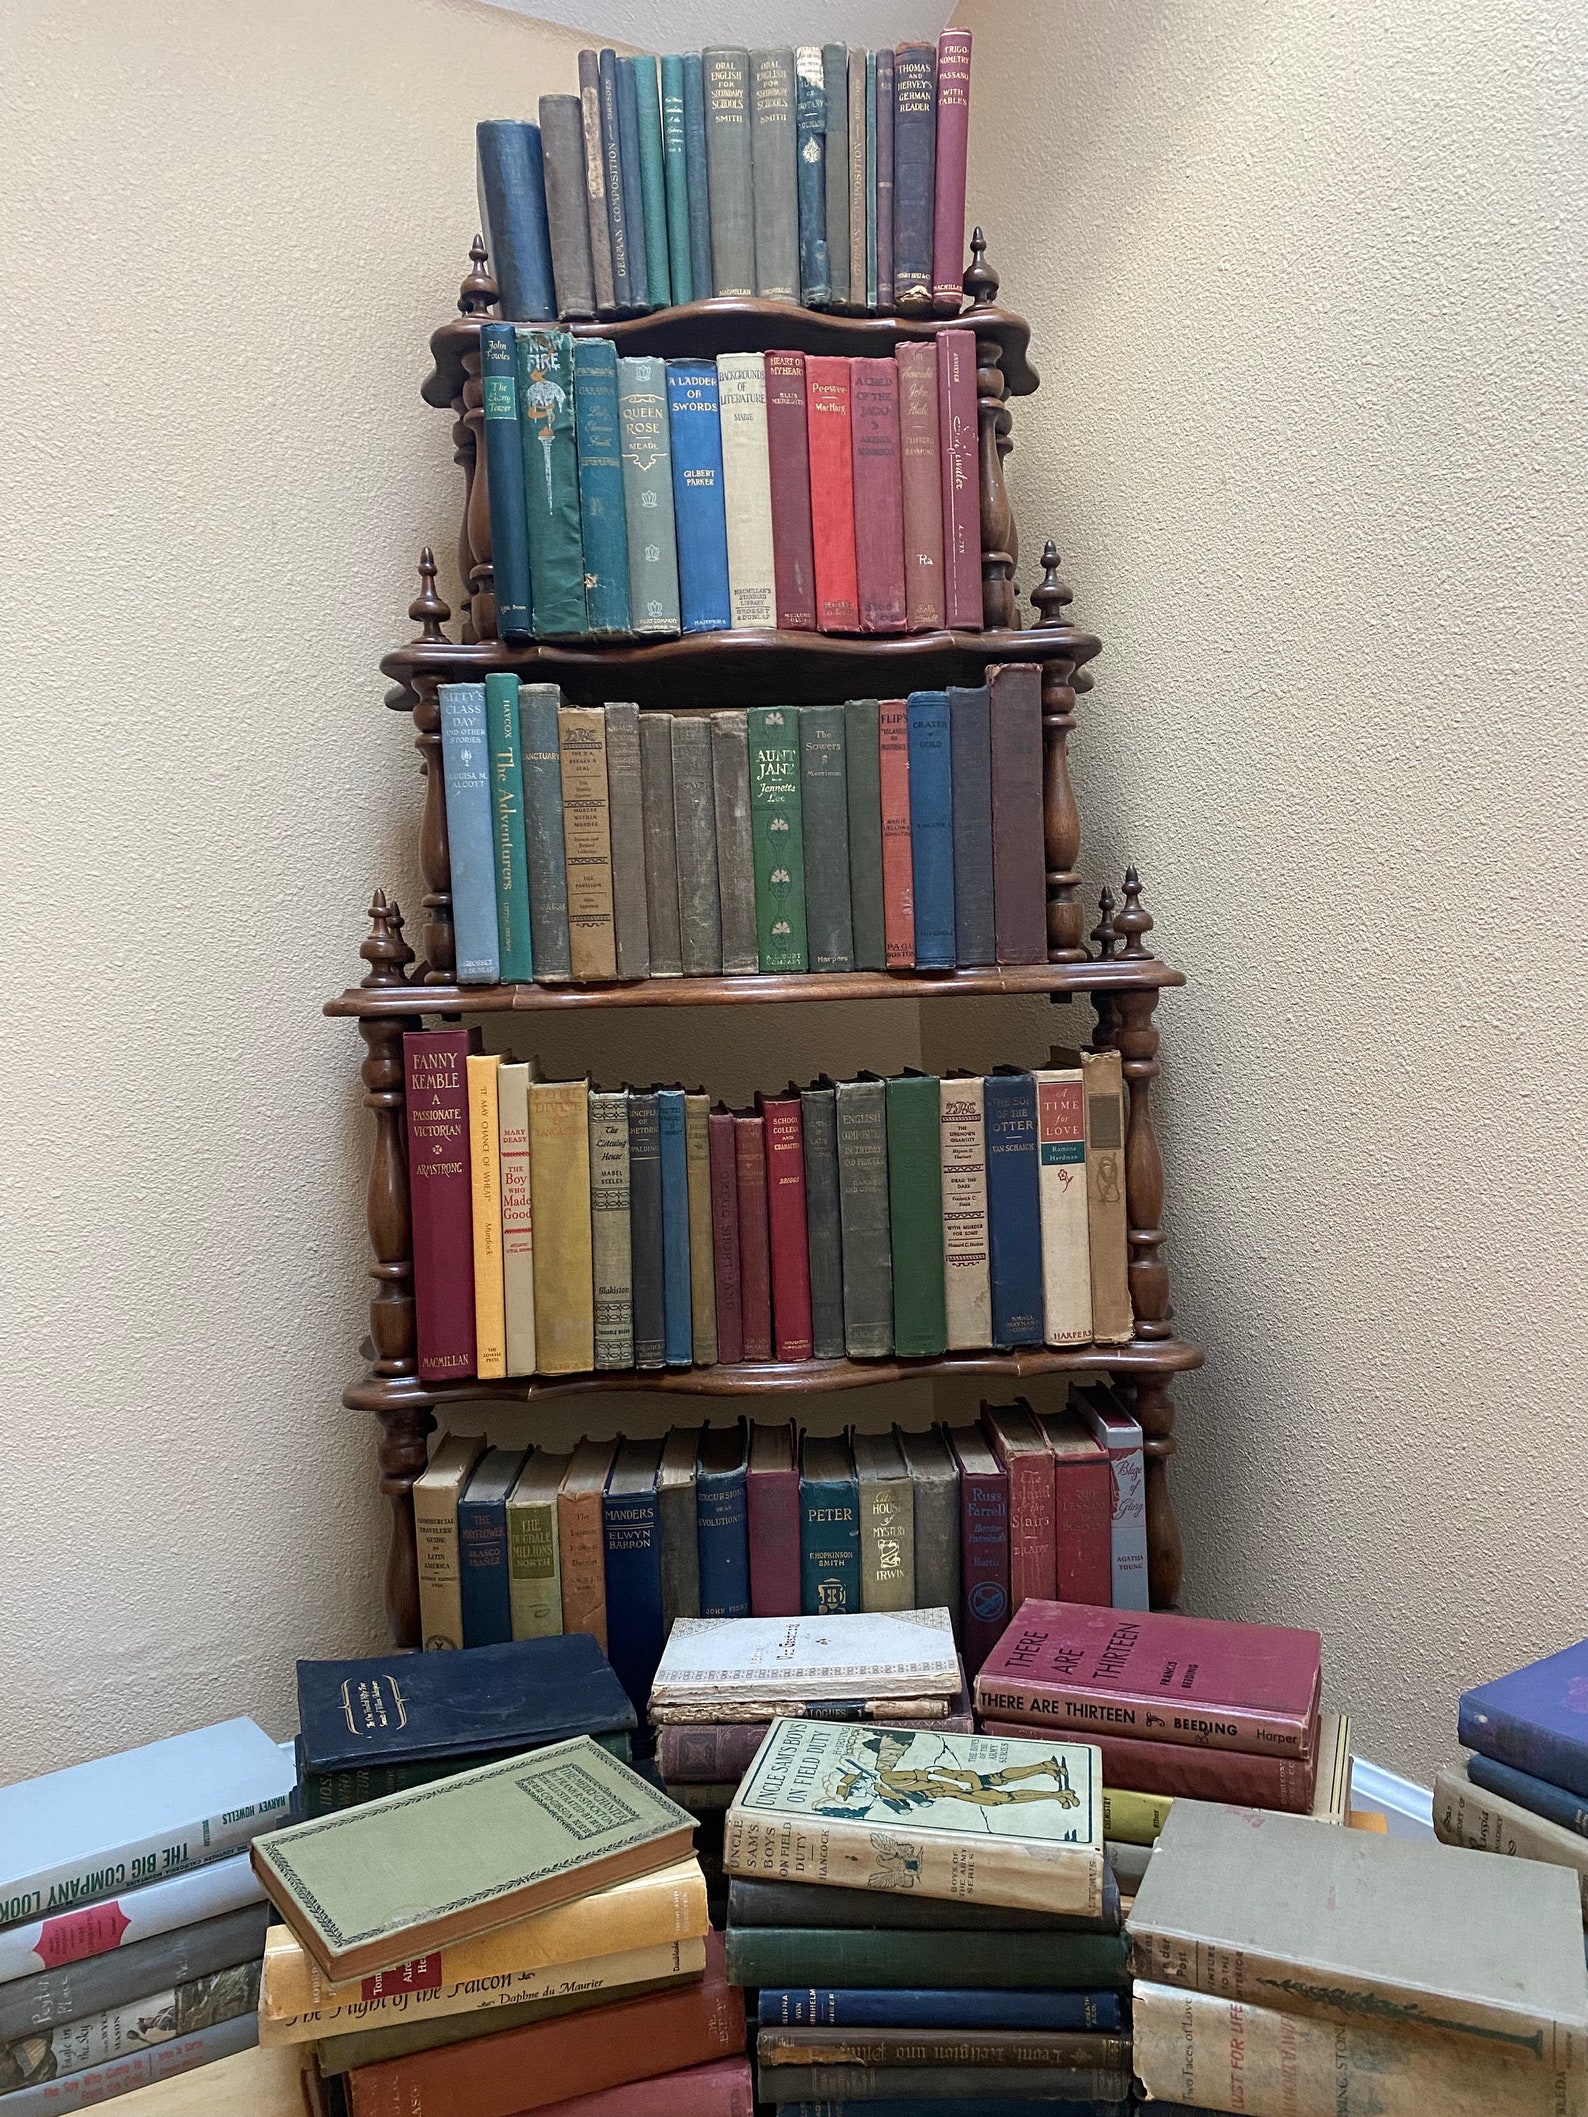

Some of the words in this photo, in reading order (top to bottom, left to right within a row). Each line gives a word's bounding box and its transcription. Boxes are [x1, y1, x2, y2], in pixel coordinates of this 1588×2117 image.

[944, 46, 969, 54] TRIGO-
[939, 56, 969, 64] NOMETRY
[760, 62, 781, 70] ORAL
[899, 63, 930, 73] THOMAS
[711, 71, 742, 81] ENGLISH
[757, 70, 787, 81] ENGLISH
[897, 80, 932, 91] HERVEY'S
[711, 90, 743, 98] SECONDARY
[756, 89, 787, 98] SECONDARY
[899, 92, 930, 100] GERMAN
[605, 79, 613, 120] DRESDEN
[712, 100, 743, 109] SCHOOLS
[757, 99, 788, 108] SCHOOLS
[938, 97, 967, 105] TABLES
[899, 103, 930, 112] READER
[716, 115, 743, 123] SMITH
[760, 114, 787, 123] SMITH
[608, 143, 621, 222] COMPOSITION
[614, 229, 626, 276] GERMAN
[488, 341, 507, 350] John
[486, 352, 510, 360] Fowles
[679, 377, 717, 386] LADDER
[720, 370, 765, 382] BACKGROUNDS
[491, 382, 507, 392] The
[738, 382, 745, 391] OF
[687, 390, 701, 398] OF
[721, 394, 765, 405] LITERATURE
[673, 403, 717, 411] SWORDS
[624, 408, 663, 419] QUEEN
[627, 423, 659, 434] ROSE
[905, 448, 934, 456] RAYMOND
[444, 690, 484, 700] KITTY'S
[446, 706, 481, 714] CLASS
[453, 717, 475, 726] DAY
[503, 700, 512, 738] HAYCOX
[913, 721, 947, 729] CRATER
[816, 730, 832, 738] The
[806, 742, 840, 750] Sowers
[756, 750, 795, 762] AUNT
[497, 747, 515, 782] The
[757, 764, 795, 780] JANE
[499, 788, 517, 890] Adventurers
[817, 956, 848, 964] Harpers
[413, 1053, 458, 1070] FANNY
[412, 1073, 459, 1089] KEMBLE
[1056, 1088, 1068, 1098] A
[432, 1094, 440, 1105] A
[1044, 1102, 1079, 1110] TIME
[412, 1109, 461, 1121] PASSIONATE
[843, 1114, 880, 1123] ENGLISH
[1056, 1113, 1070, 1124] for
[993, 1121, 1033, 1132] OTTER
[1046, 1125, 1079, 1136] LOVE
[414, 1125, 461, 1142] VICTORIAN
[596, 1140, 627, 1148] Listening
[1005, 1143, 1035, 1151] SCHAICK
[482, 1156, 489, 1167] OF
[601, 1152, 622, 1161] House
[416, 1162, 462, 1179] ARMSTRONG
[505, 1174, 527, 1185] Boy
[779, 1177, 800, 1185] BRIGGS
[504, 1195, 531, 1207] Made
[504, 1209, 531, 1220] Good
[485, 1223, 493, 1255] Murdock
[599, 1287, 629, 1295] Blakiston
[1054, 1330, 1092, 1340] HARPERS
[423, 1354, 469, 1367] MACMILLAN
[606, 1508, 653, 1520] MANDERS
[808, 1508, 853, 1522] PETER
[968, 1503, 1005, 1516] Farrell
[1012, 1515, 1050, 1529] Stairs
[512, 1534, 550, 1544] DUGDALE
[610, 1530, 650, 1540] ELWYN
[609, 1539, 650, 1549] BARRON
[512, 1545, 552, 1557] MILLIONS
[516, 1558, 550, 1567] NORTH
[1117, 1555, 1143, 1563] AGATHA
[876, 1570, 904, 1581] IRWIN
[1005, 1631, 1049, 1668] THERE
[1092, 1622, 1142, 1679] THIRTEEN
[1052, 1648, 1085, 1675] ARE
[1160, 1660, 1178, 1687] FRANCIS
[1181, 1663, 1198, 1689] BEEDING
[980, 1692, 1025, 1711] THERE
[1029, 1699, 1060, 1714] ARE
[1065, 1701, 1136, 1724] THIRTEEN
[1173, 1718, 1238, 1737] BEEDING
[1256, 1728, 1298, 1745] Harper
[808, 1730, 831, 1754] DUTY
[756, 1774, 784, 1806] UNCLE
[772, 1745, 797, 1777] SAM'S
[787, 1723, 808, 1746] BOYS
[795, 1757, 820, 1786] FIELD
[787, 1788, 806, 1804] ON
[258, 1795, 286, 1814] HARVEY
[222, 1806, 255, 1825] HOWELLS
[731, 1820, 743, 1868] UNCLE
[747, 1824, 760, 1867] SAM'S
[781, 1822, 792, 1859] FIELD
[162, 1843, 189, 1862] THE
[764, 1827, 776, 1869] BOYS
[796, 1832, 807, 1871] DUTY
[819, 1829, 830, 1880] HANCOCK
[132, 1854, 157, 1878] BIG
[779, 1861, 788, 1877] ON
[50, 1863, 125, 1908] COMPANY
[0, 1891, 41, 1924] LOOK
[498, 1990, 539, 2005] Daphne
[543, 1987, 555, 1997] du
[560, 1978, 604, 1994] Maurier
[1182, 1998, 1193, 2030] Love
[1230, 2004, 1243, 2038] LIFE
[1186, 2032, 1193, 2042] of
[1182, 2043, 1194, 2075] Faces
[1231, 2039, 1245, 2070] FOR
[1231, 2074, 1245, 2110] LUST
